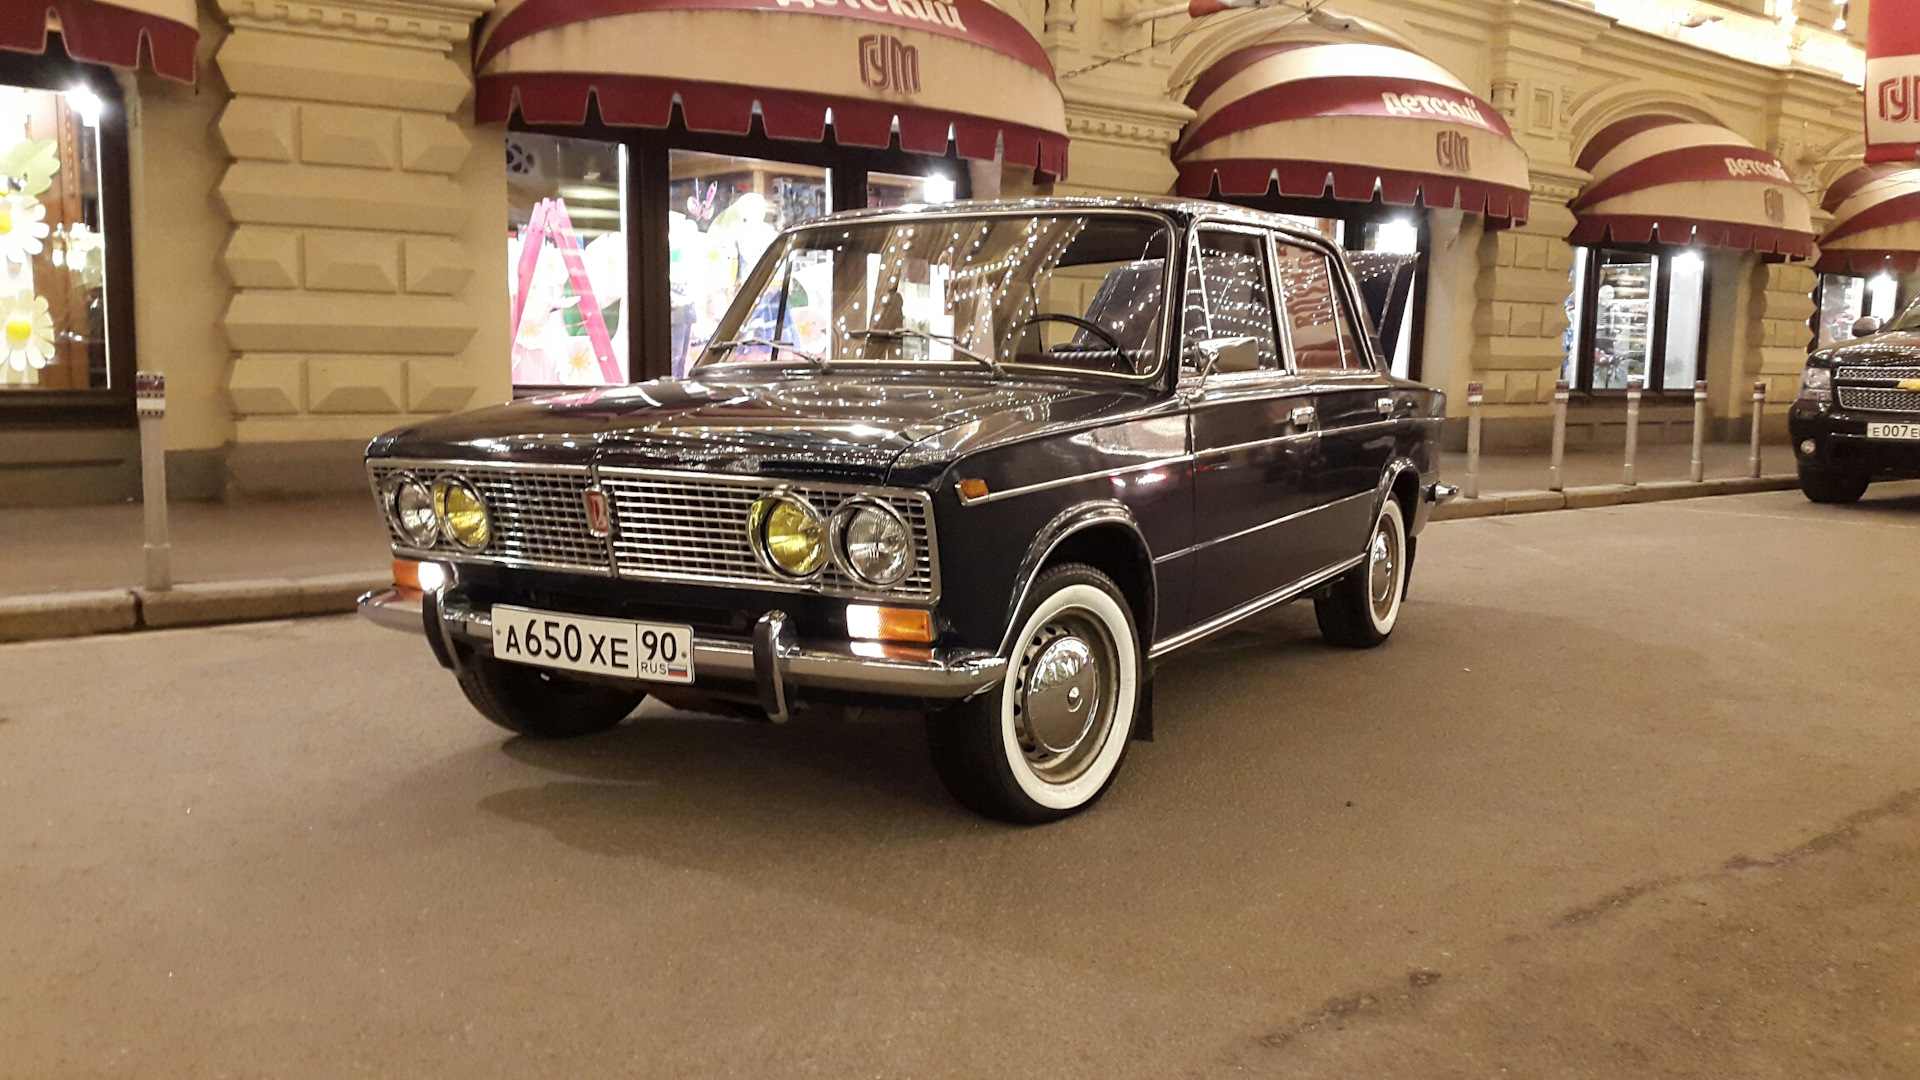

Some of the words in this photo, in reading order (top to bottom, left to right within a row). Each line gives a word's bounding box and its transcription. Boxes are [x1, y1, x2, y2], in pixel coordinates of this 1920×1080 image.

[858, 34, 921, 94] ГУМ
[1879, 75, 1920, 122] ГУ
[1436, 130, 1471, 172] ГУМ
[1872, 424, 1920, 438] Е007Е
[642, 630, 677, 662] 90
[641, 661, 667, 675] RUS
